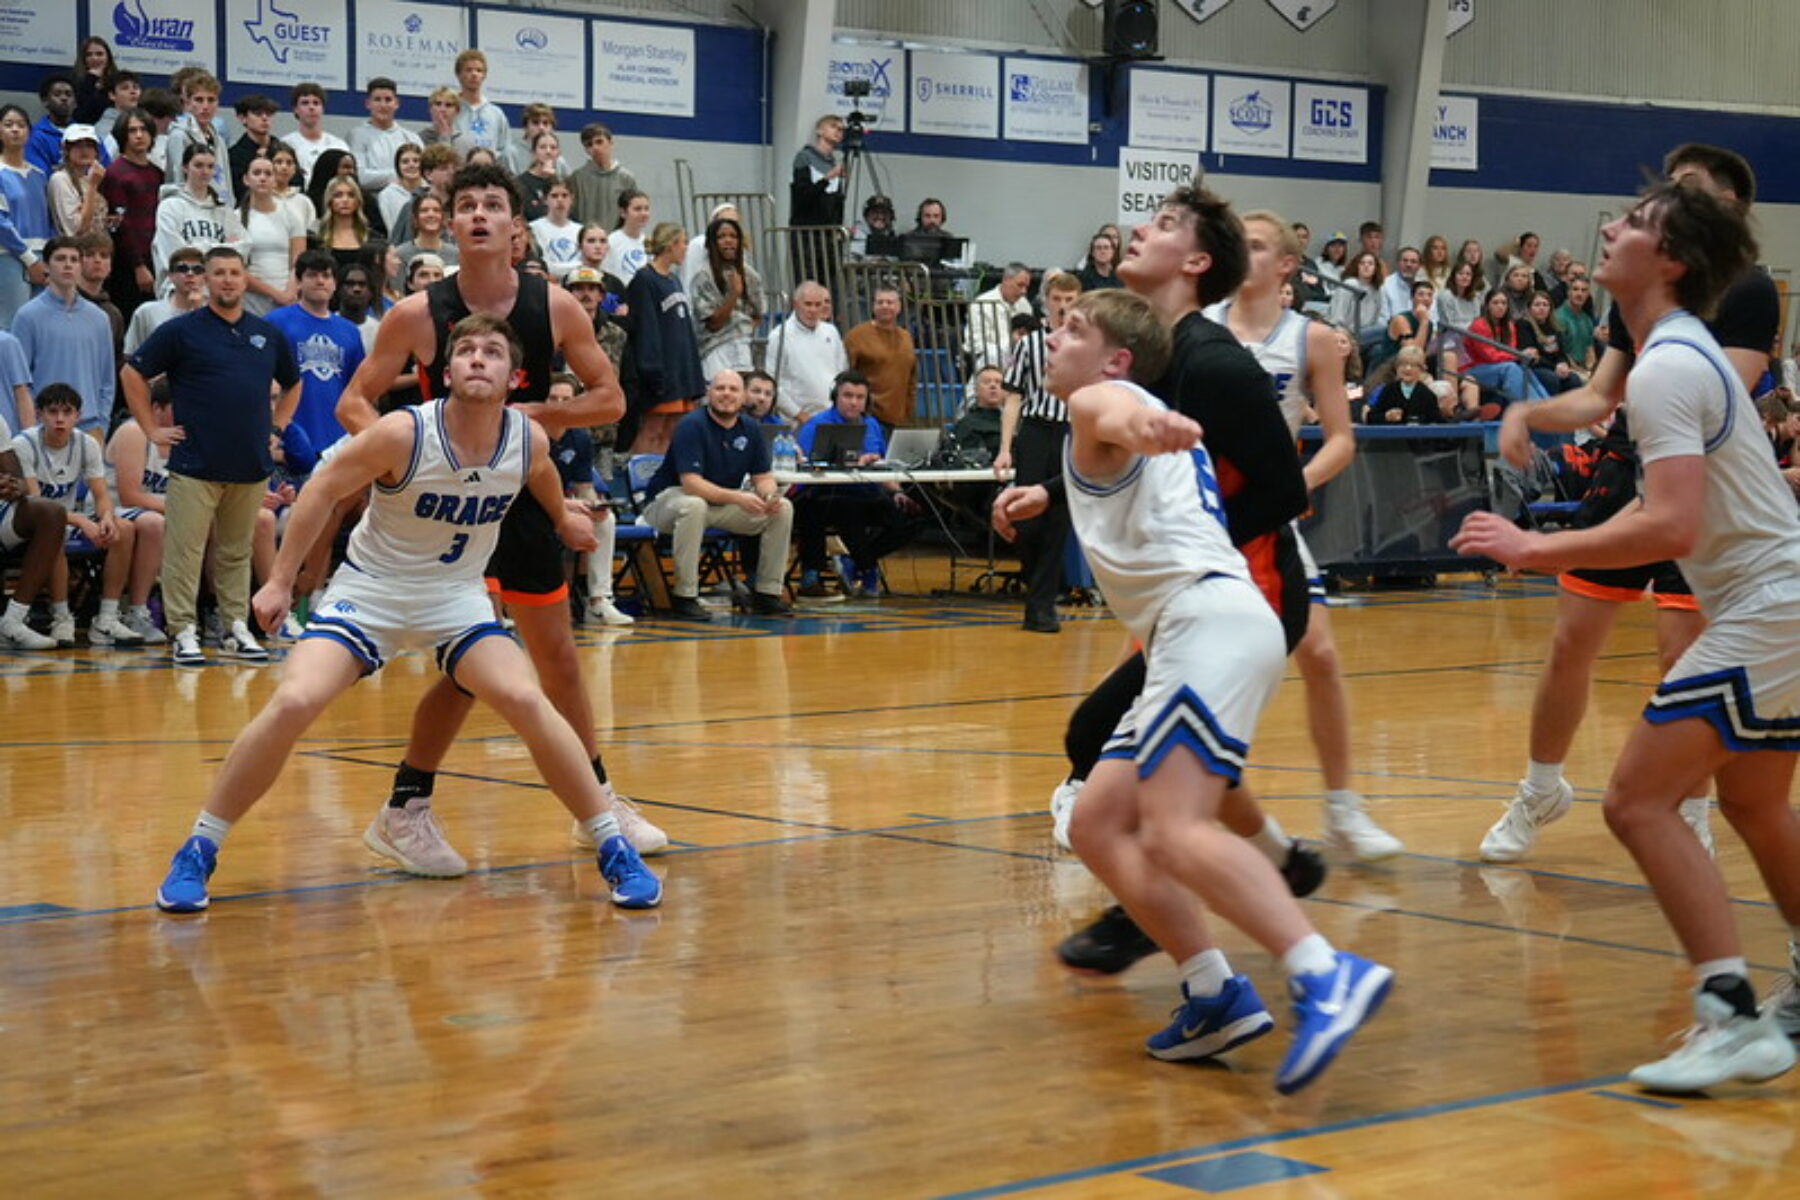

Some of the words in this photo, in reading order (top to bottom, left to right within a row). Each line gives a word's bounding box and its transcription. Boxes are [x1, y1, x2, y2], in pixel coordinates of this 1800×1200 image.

[274, 22, 331, 43] GUEST
[367, 33, 459, 54] ROSEMAN
[602, 41, 644, 60] Morgan
[646, 44, 688, 66] Stanley
[936, 83, 993, 99] SHERRILL
[1311, 98, 1352, 127] GCS
[1126, 161, 1192, 182] VISITOR
[414, 492, 514, 525] GRACE
[439, 533, 469, 564] 3
